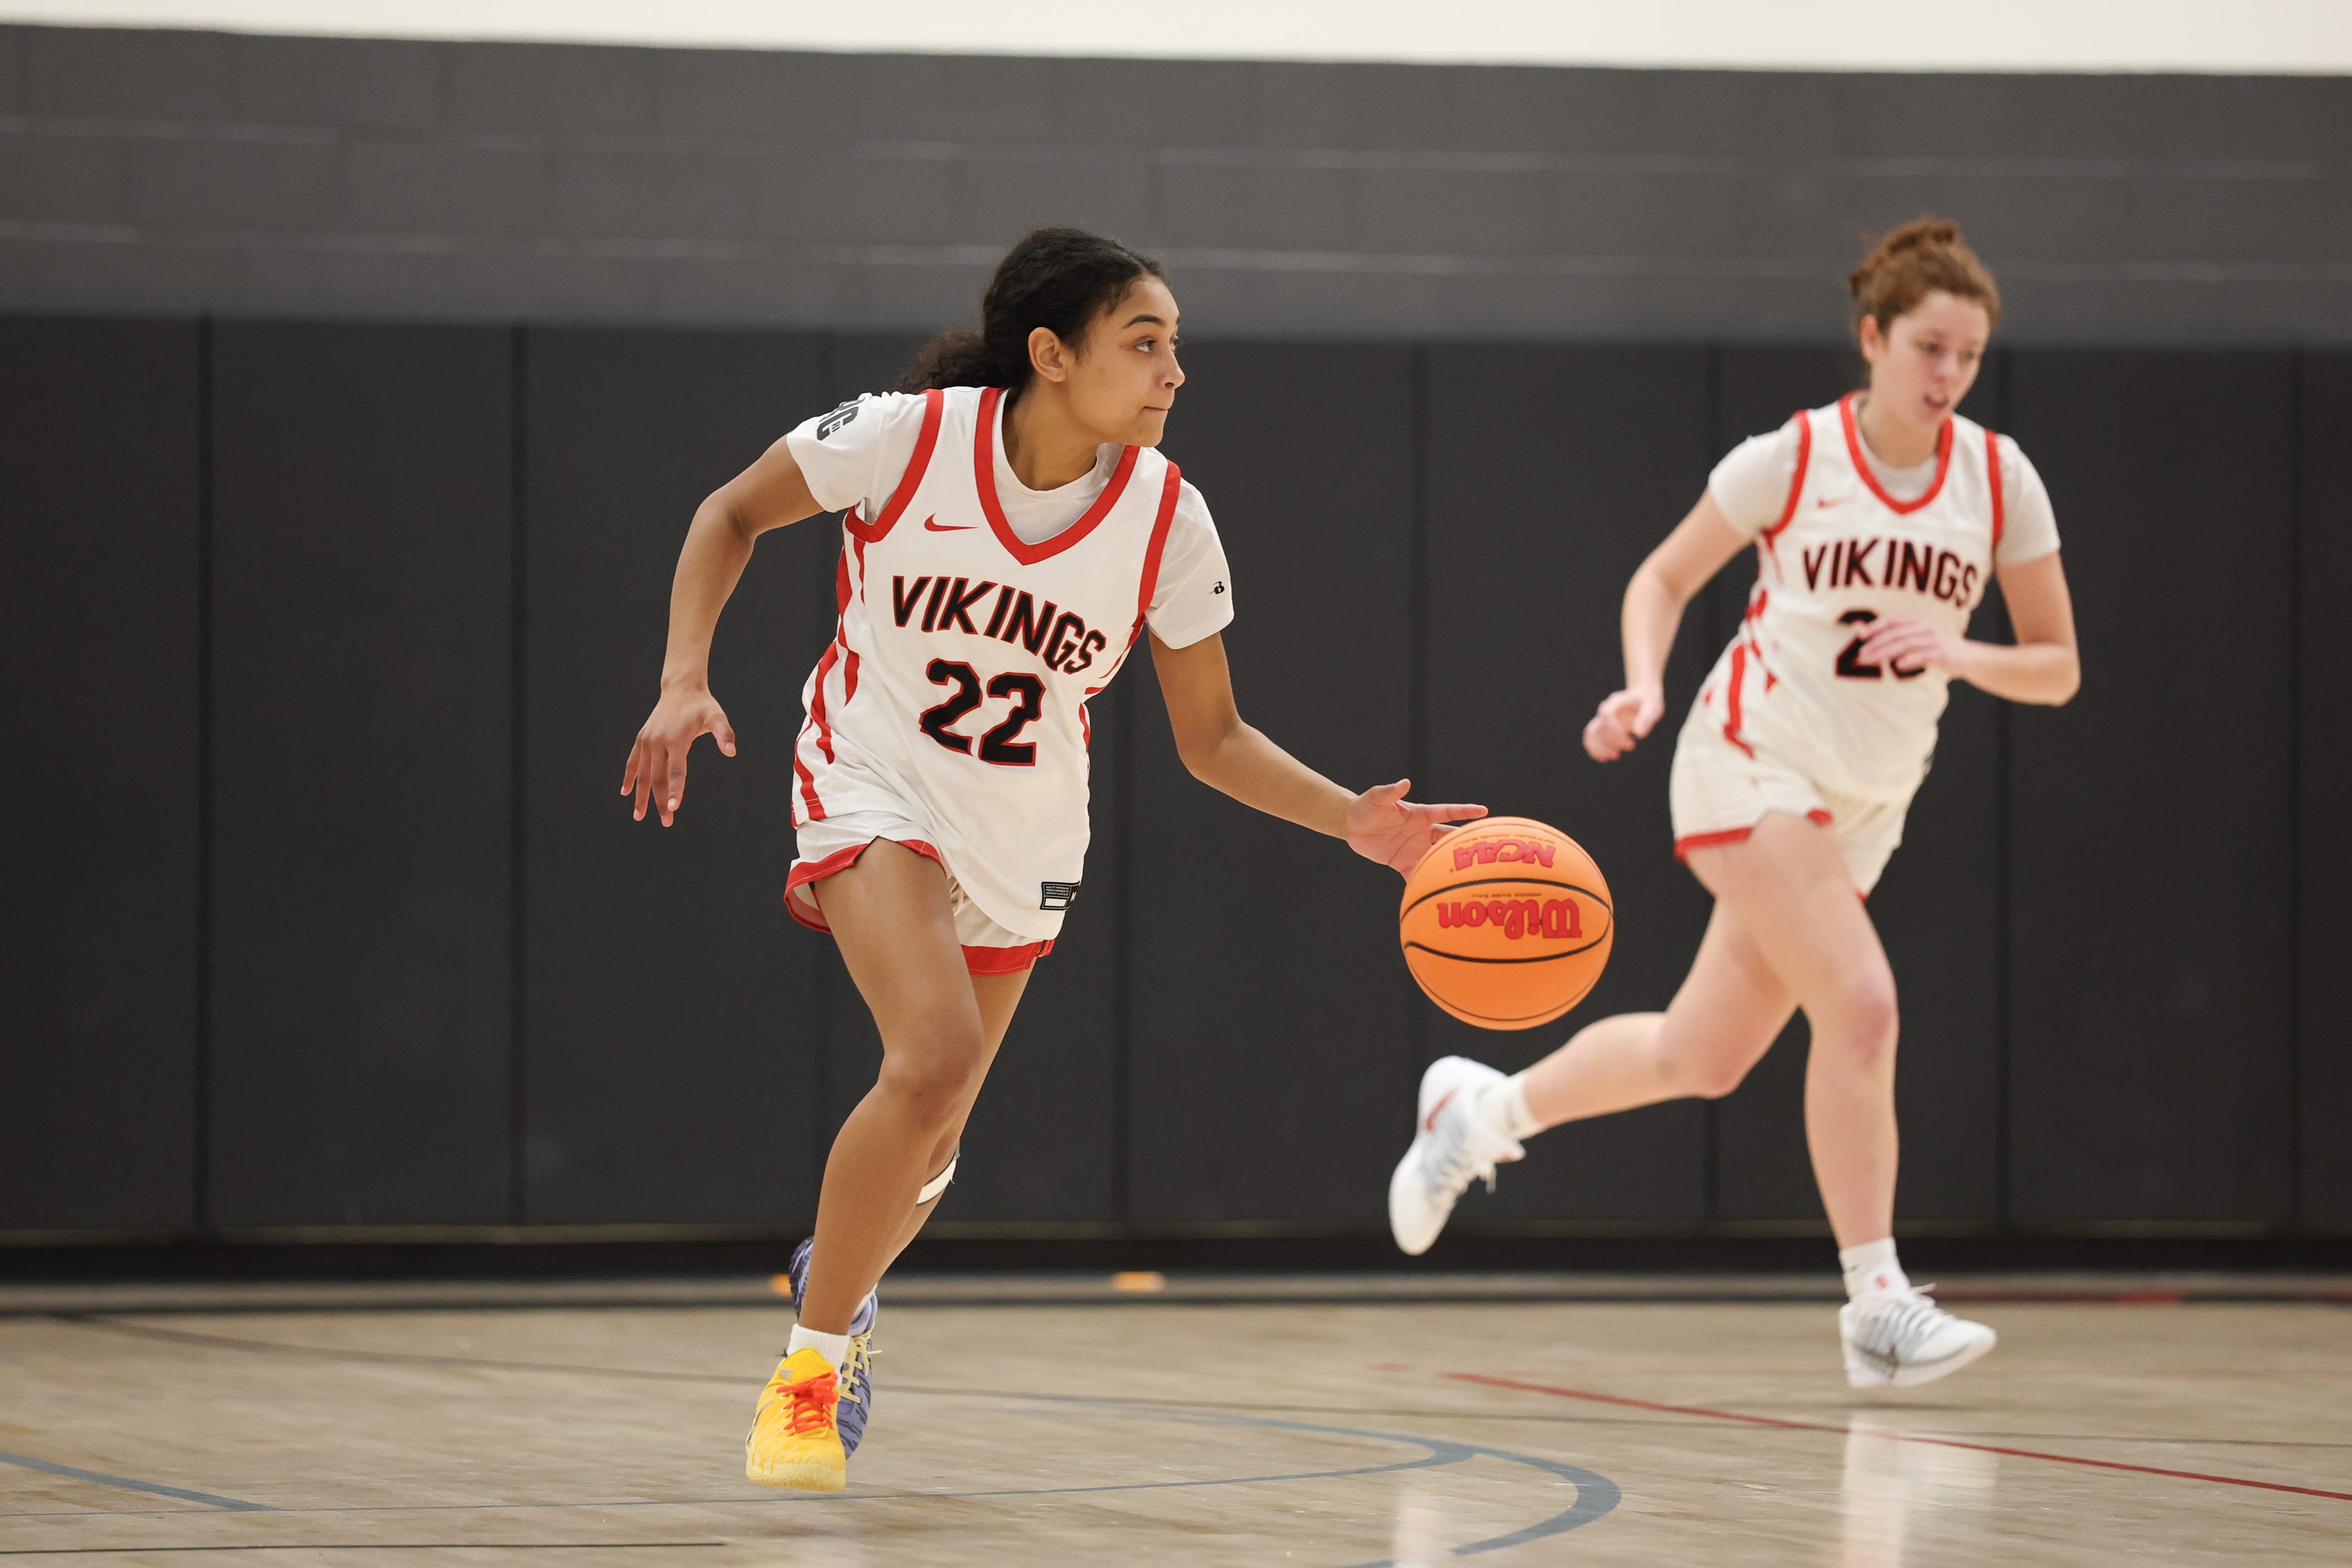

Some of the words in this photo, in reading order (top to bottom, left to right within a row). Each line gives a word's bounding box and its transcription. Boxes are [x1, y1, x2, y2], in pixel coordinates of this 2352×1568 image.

[1803, 538, 1976, 608] VIKINGS
[892, 575, 1107, 674] VIKINGS
[1835, 608, 1926, 680] 2
[919, 658, 1047, 766] 22
[1453, 840, 1556, 871] NCAA
[1437, 899, 1582, 940] Wilson
